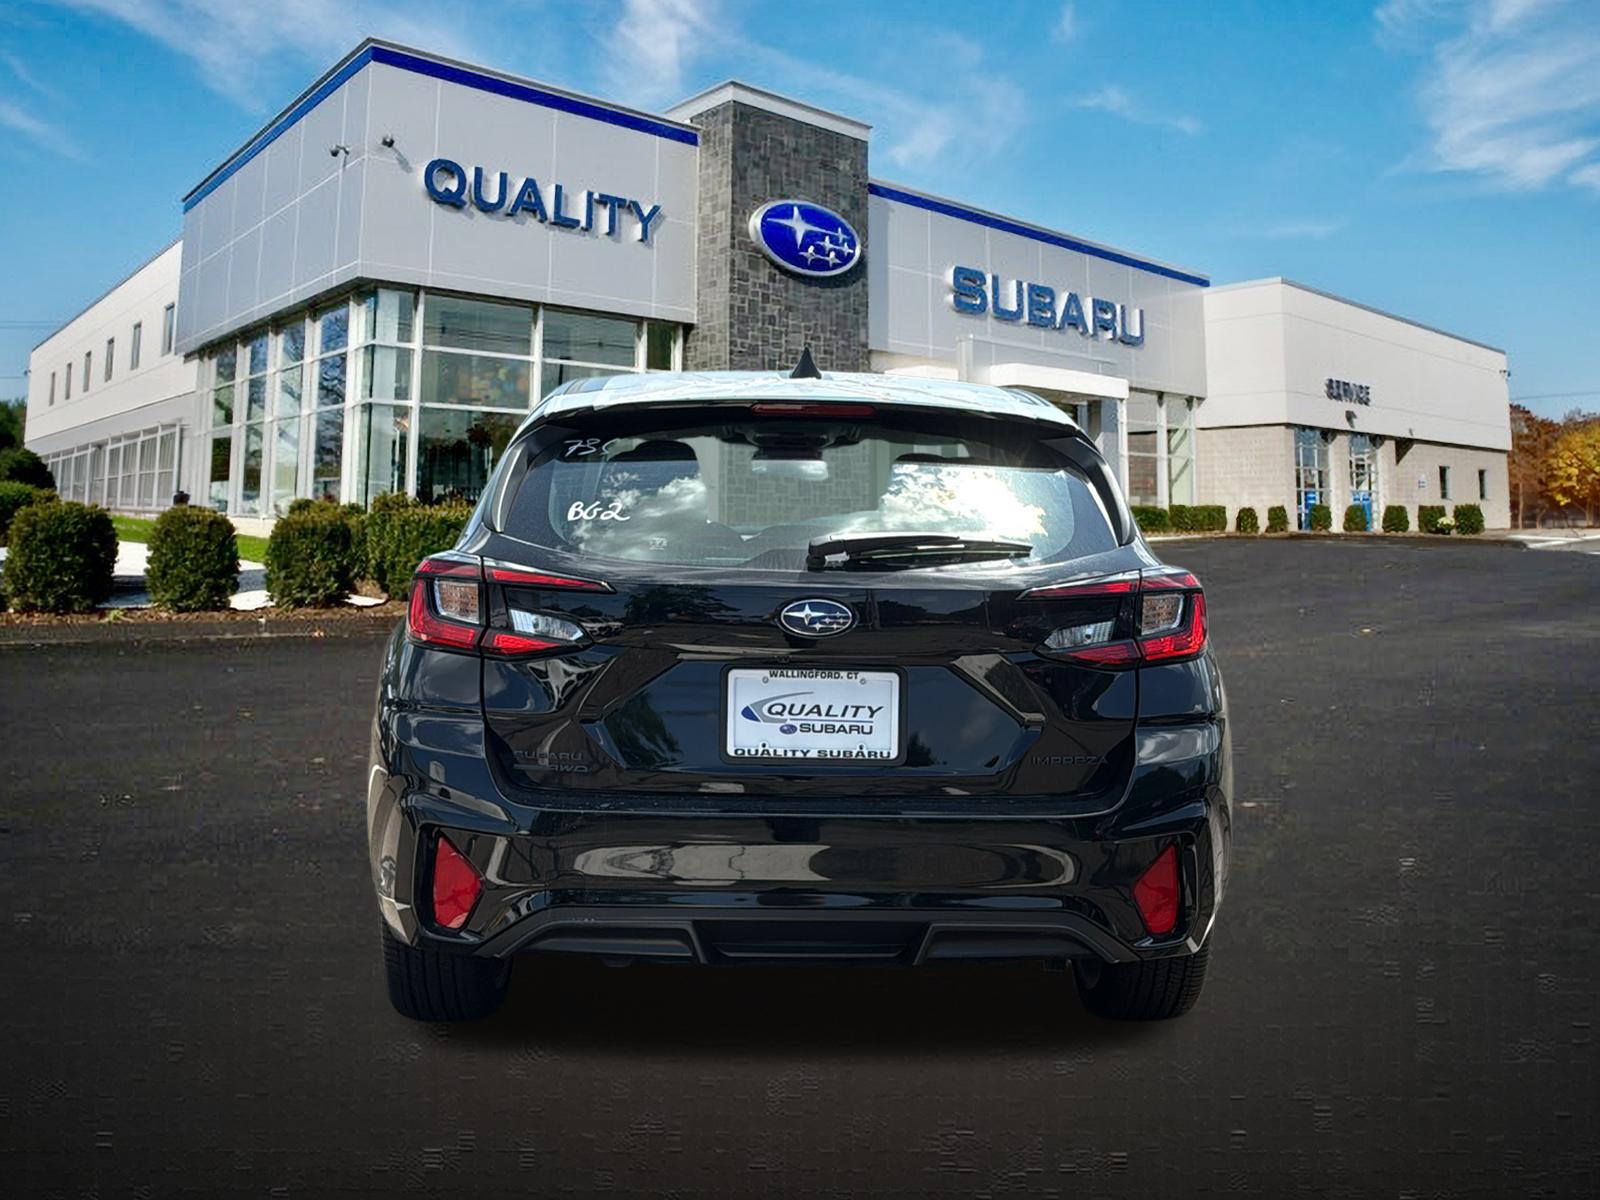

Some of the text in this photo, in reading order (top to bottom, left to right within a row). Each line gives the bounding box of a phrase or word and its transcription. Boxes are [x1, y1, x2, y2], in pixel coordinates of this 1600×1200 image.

[424, 158, 661, 242] QUALITY
[952, 265, 1144, 346] SUBARU
[846, 671, 859, 680] CT
[767, 702, 884, 719] QUALITY
[799, 723, 873, 735] SUBARU
[513, 750, 583, 761] SUBARU
[734, 748, 891, 759] QUALITY SUBARU
[1031, 756, 1108, 765] IMPREZA
